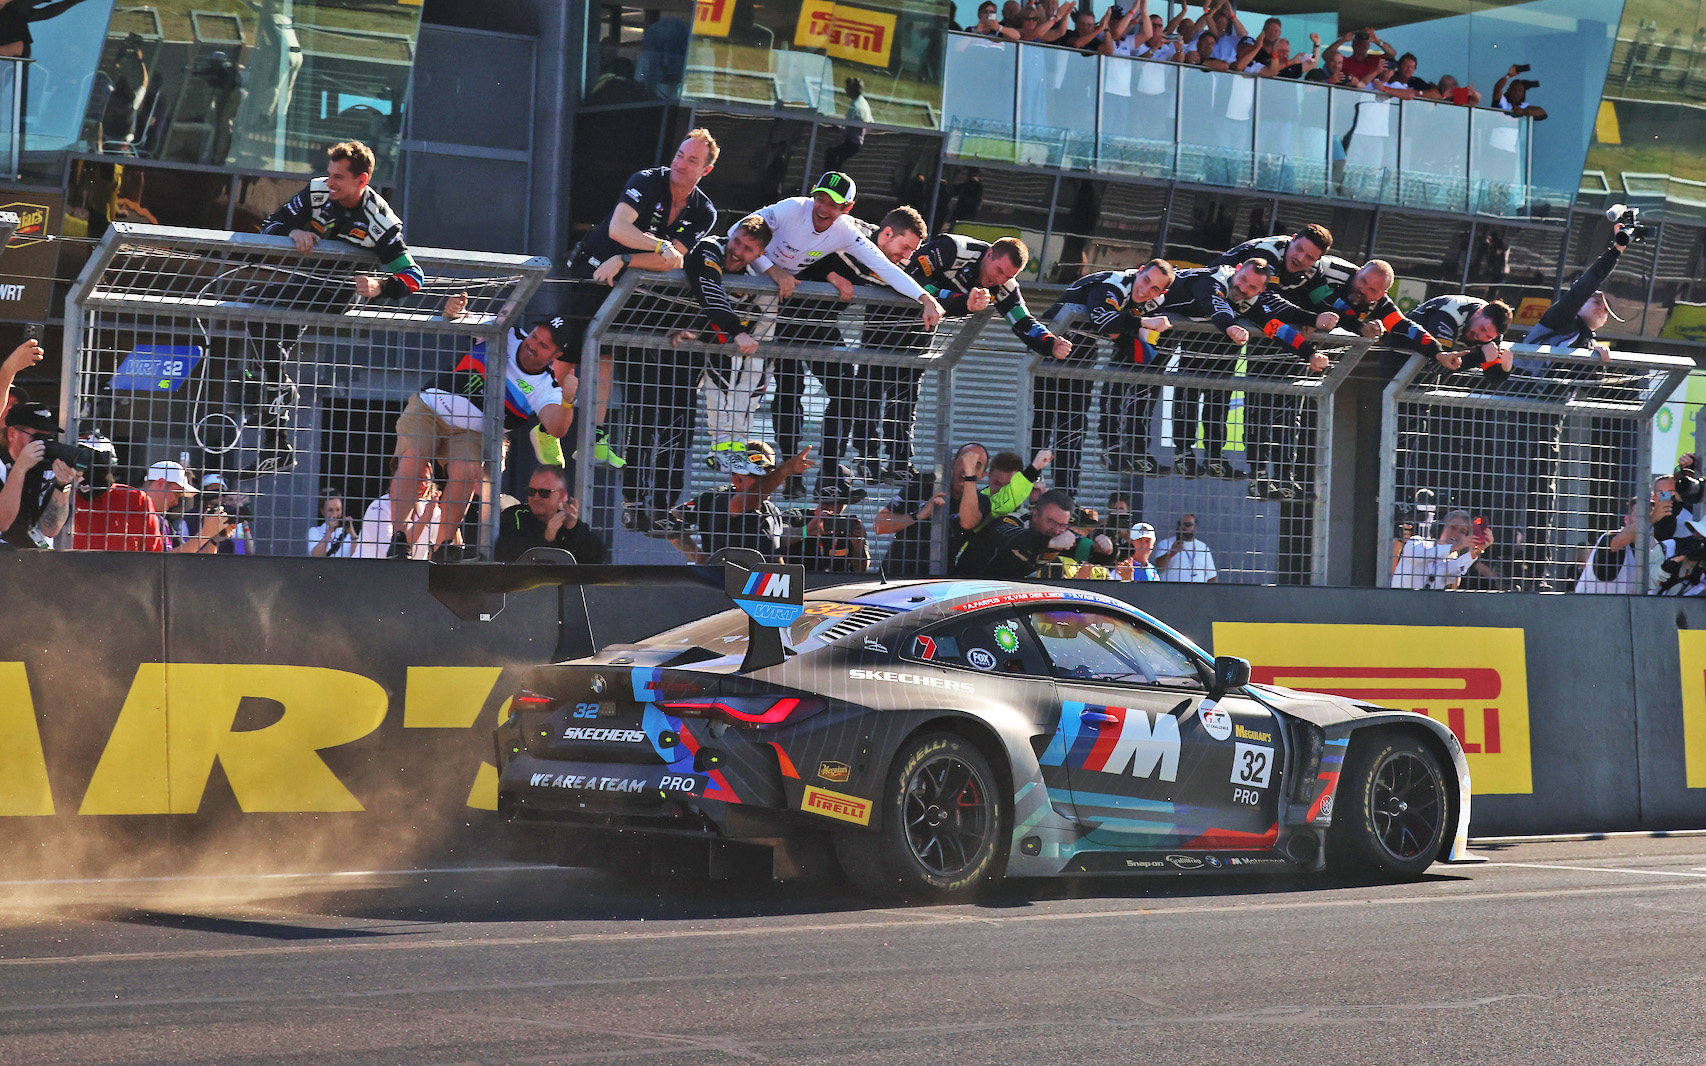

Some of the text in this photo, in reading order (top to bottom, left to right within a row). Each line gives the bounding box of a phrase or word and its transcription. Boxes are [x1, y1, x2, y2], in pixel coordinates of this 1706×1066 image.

[125, 359, 183, 376] WRT 32
[762, 573, 791, 598] M
[753, 603, 798, 621] WRT
[804, 603, 862, 618] 32
[972, 652, 989, 664] FOX
[848, 669, 976, 694] SKECHERS
[573, 702, 599, 719] 32
[563, 727, 646, 743] SKECHERS
[1101, 708, 1181, 782] M
[1240, 750, 1266, 783] 32
[530, 772, 647, 793] WE ARE A TEAM
[658, 775, 696, 792] PRO
[808, 792, 866, 818] PIRELLI
[1233, 788, 1259, 806] PRO
